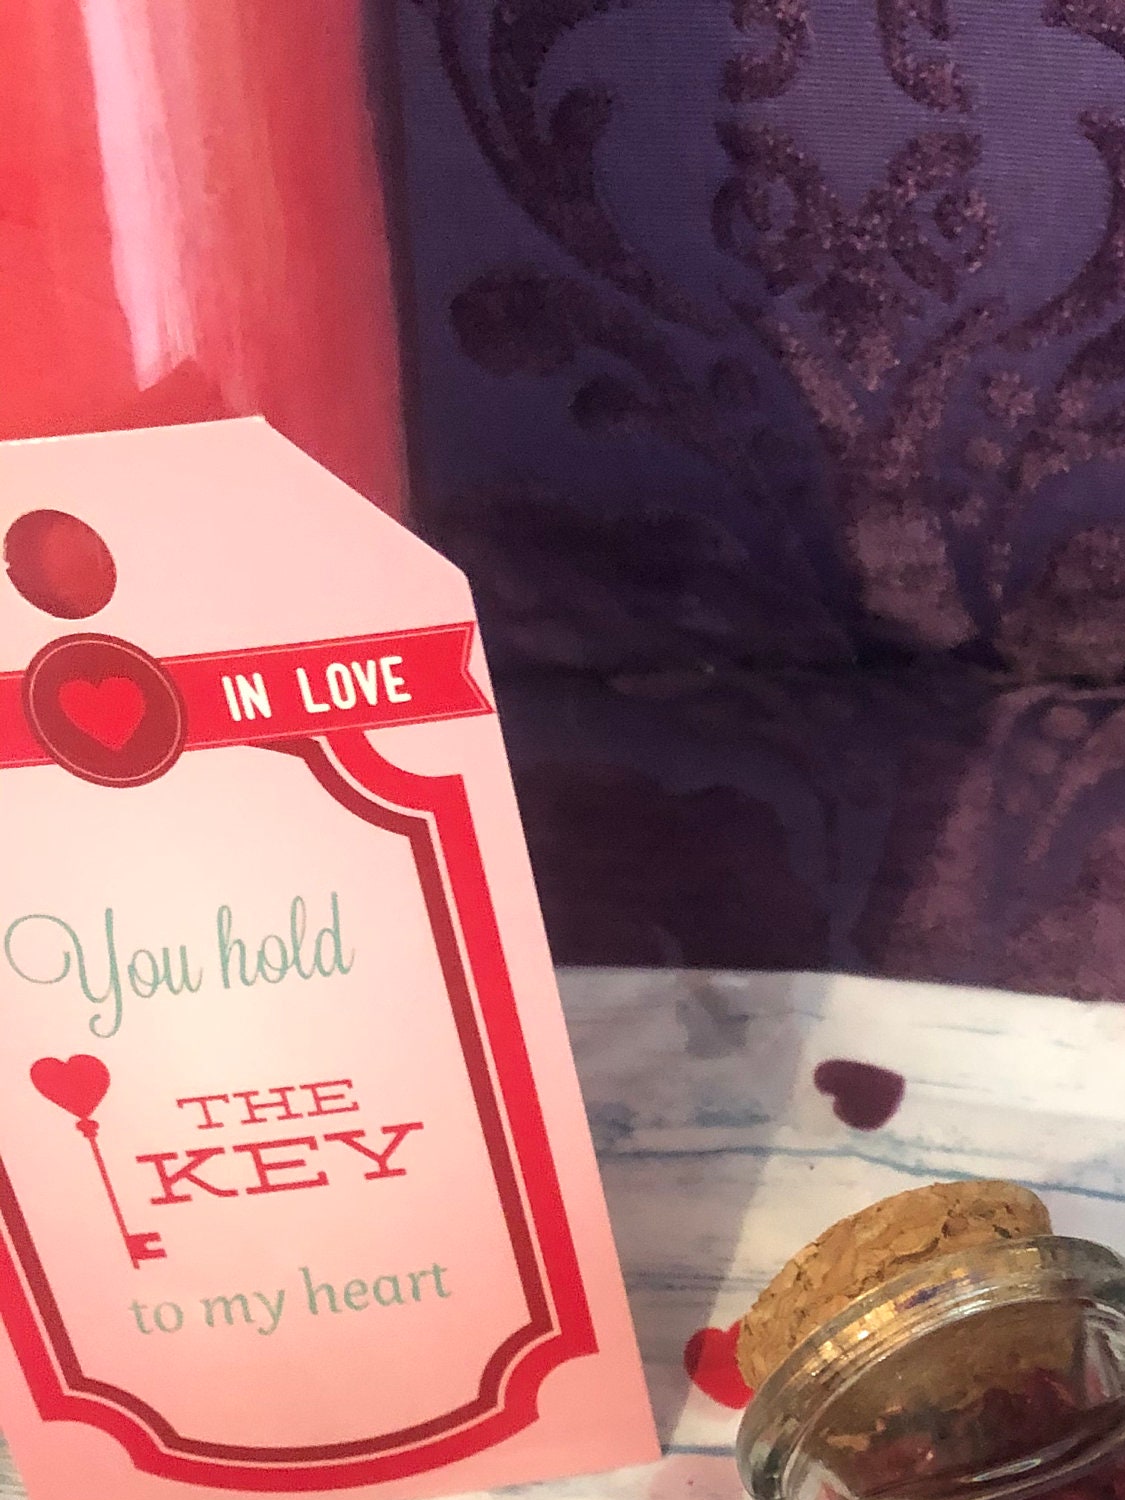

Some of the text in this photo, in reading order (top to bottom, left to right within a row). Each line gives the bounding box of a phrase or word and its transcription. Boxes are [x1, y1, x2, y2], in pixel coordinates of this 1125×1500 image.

[221, 656, 412, 721] IN LOVE
[4, 891, 355, 1038] You hold
[176, 1079, 360, 1129] THE
[135, 1121, 425, 1205] KEY
[128, 1262, 452, 1336] to my heart
